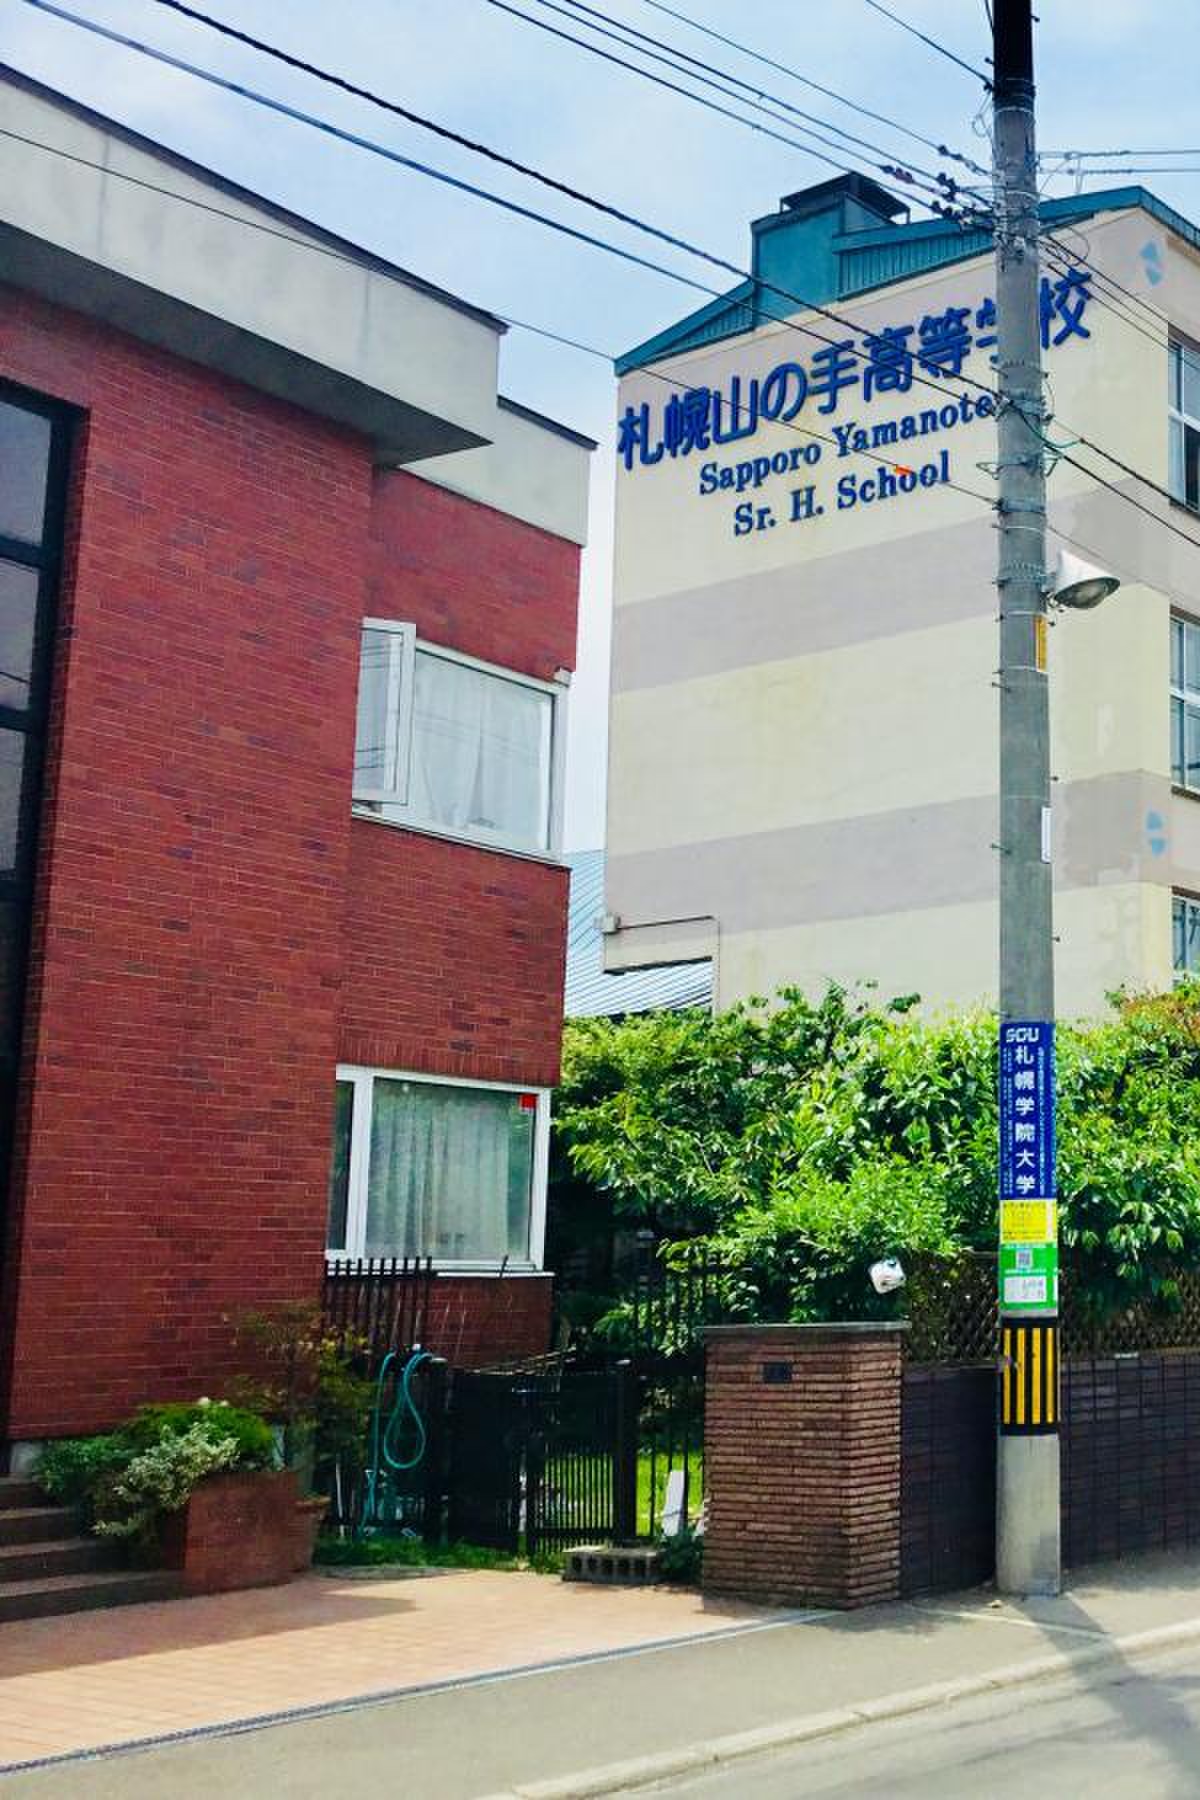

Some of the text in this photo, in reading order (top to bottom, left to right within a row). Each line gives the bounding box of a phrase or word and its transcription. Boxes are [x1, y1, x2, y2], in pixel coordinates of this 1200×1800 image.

[699, 393, 994, 495] Sapporo Yamanote
[733, 450, 951, 537] Sr. H. School
[1014, 1045, 1036, 1195] 札幌学院大学
